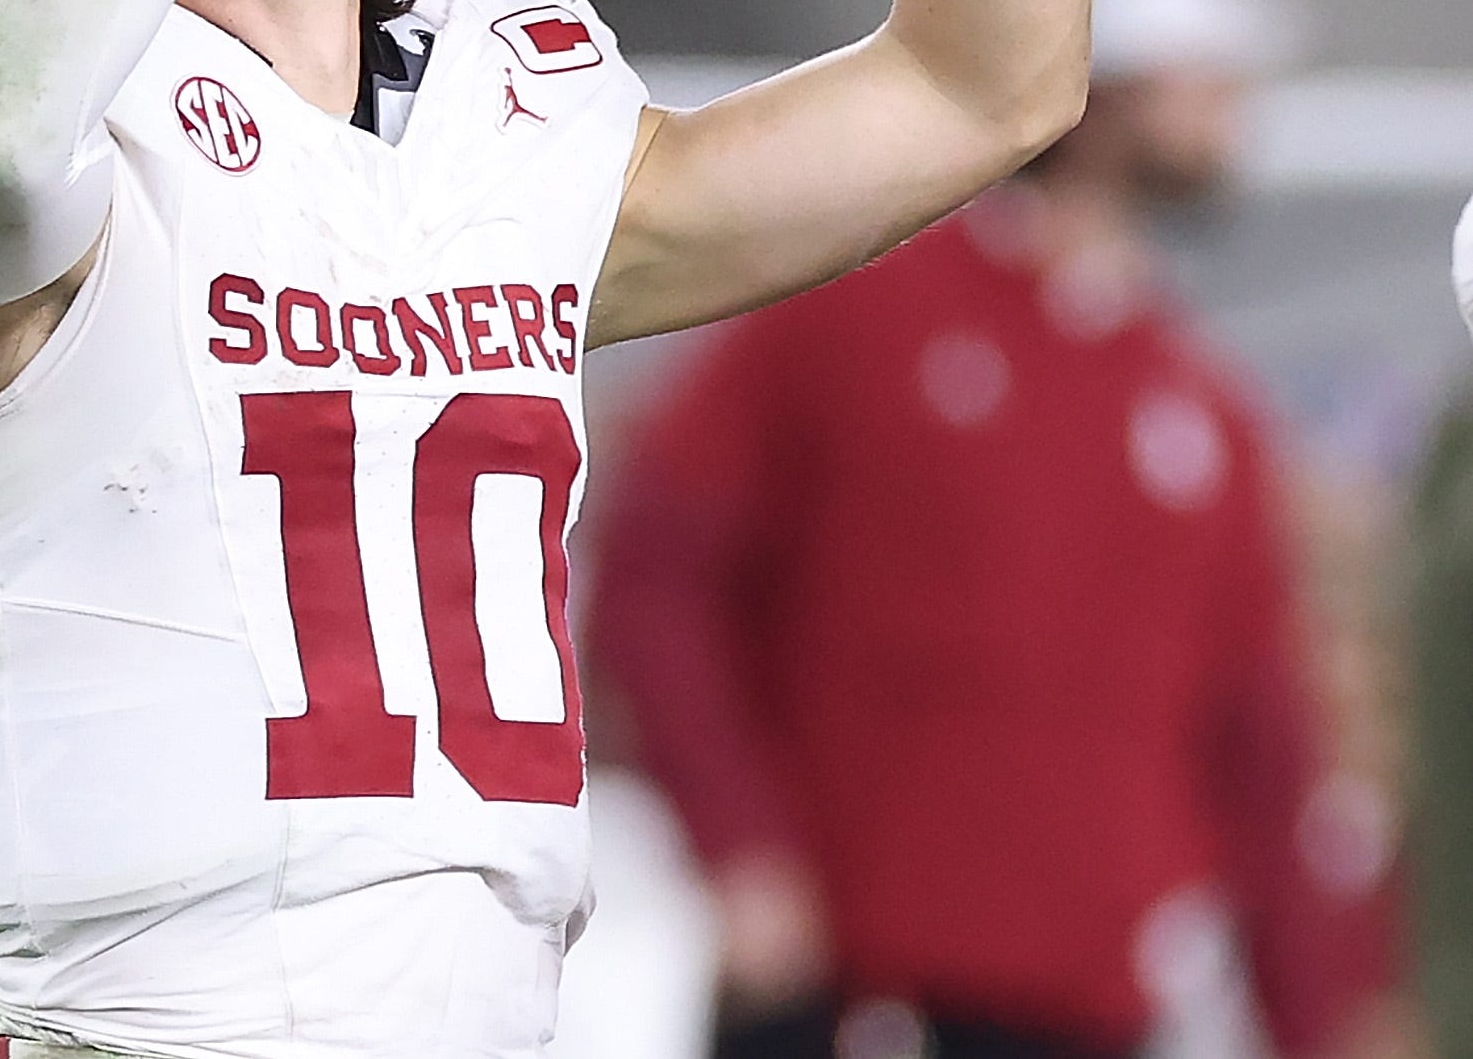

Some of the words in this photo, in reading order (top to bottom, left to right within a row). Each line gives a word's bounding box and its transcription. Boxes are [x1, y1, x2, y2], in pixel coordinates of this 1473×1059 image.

[174, 76, 262, 172] SEC
[207, 272, 579, 376] SOONERS
[239, 389, 582, 808] 10
